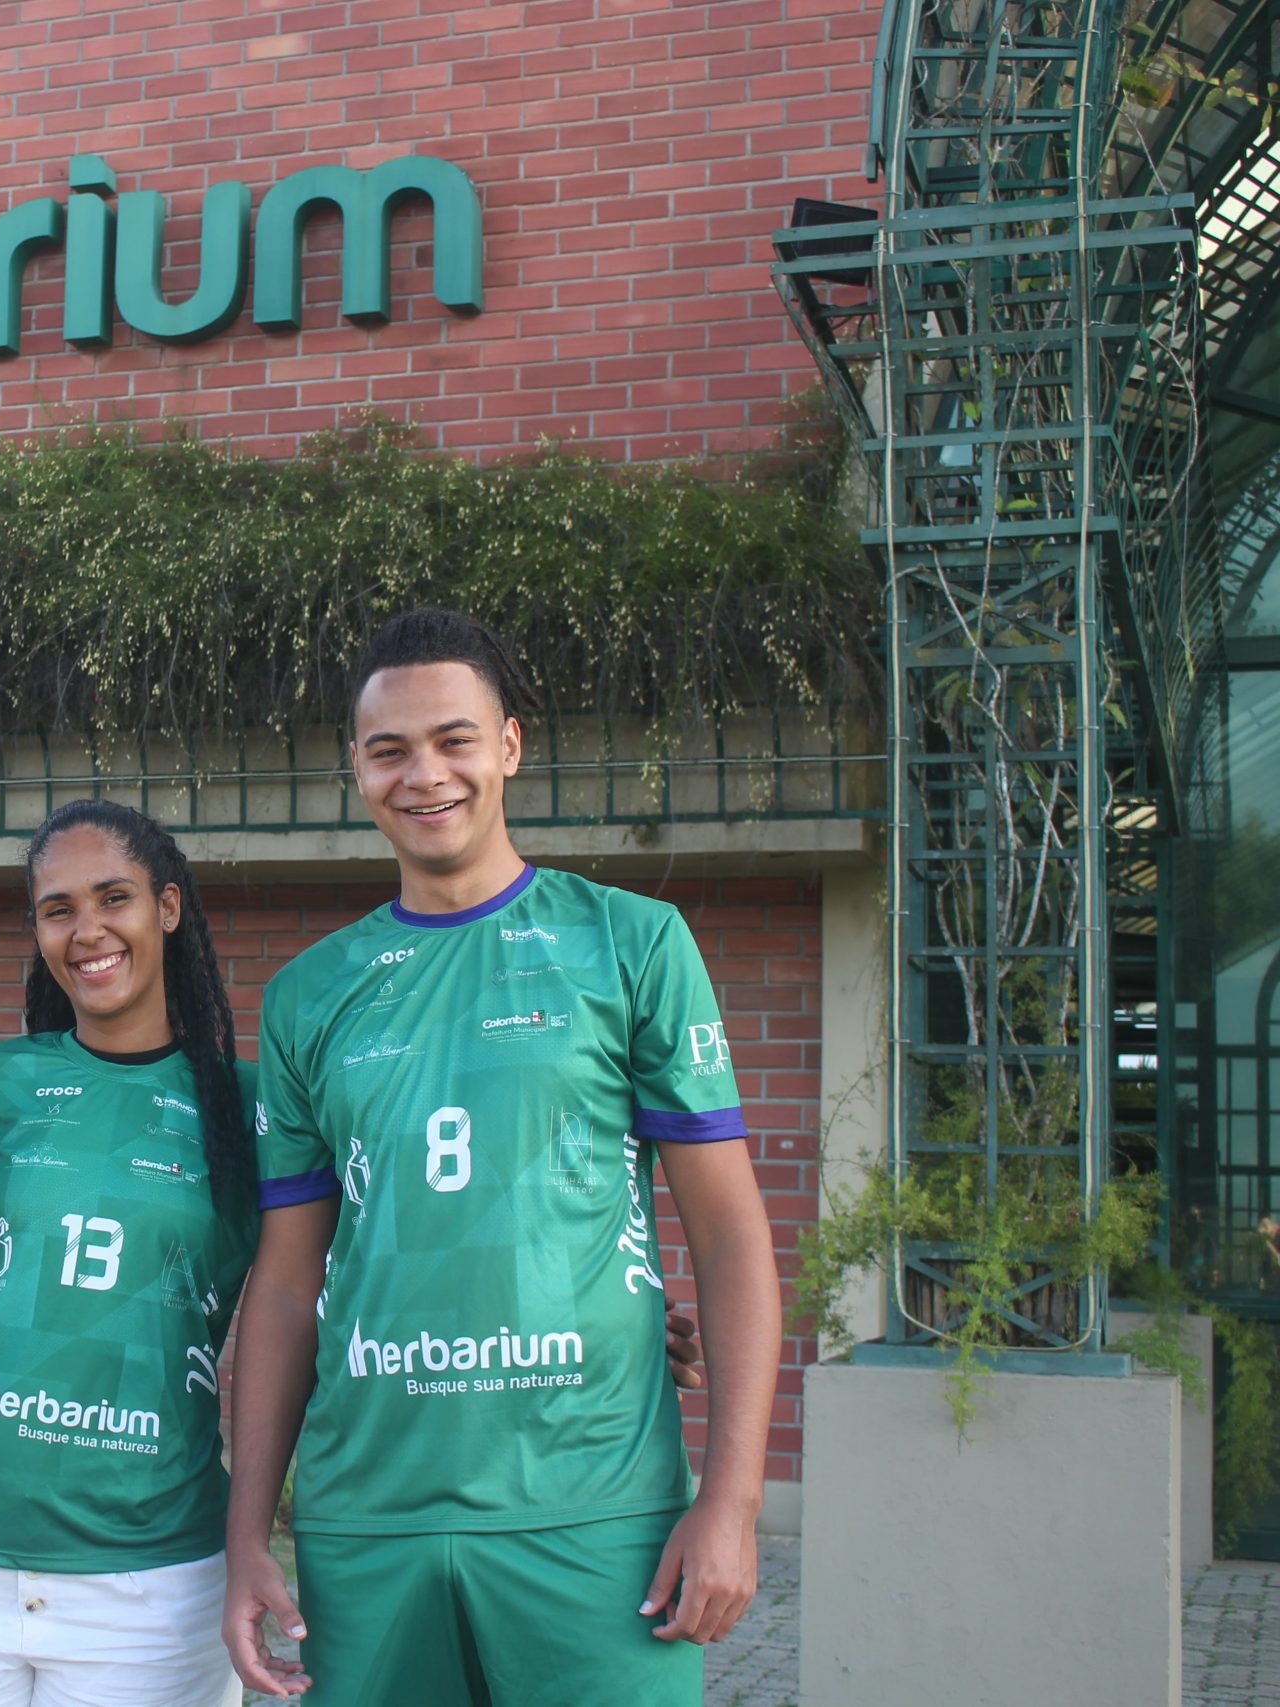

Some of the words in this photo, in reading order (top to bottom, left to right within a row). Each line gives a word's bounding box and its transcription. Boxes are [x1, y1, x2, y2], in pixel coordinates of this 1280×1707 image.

[482, 1014, 531, 1029] Colombo
[36, 1086, 83, 1097] crocs
[426, 1106, 471, 1192] 8
[131, 1158, 171, 1172] Colombo
[60, 1213, 125, 1291] 13
[348, 1317, 583, 1378] herbarium
[406, 1379, 468, 1397] Busque
[473, 1378, 505, 1391] sua
[509, 1372, 582, 1390] natureza
[18, 1424, 70, 1444] Busque
[73, 1434, 98, 1448] sua
[101, 1438, 158, 1455] natureza
